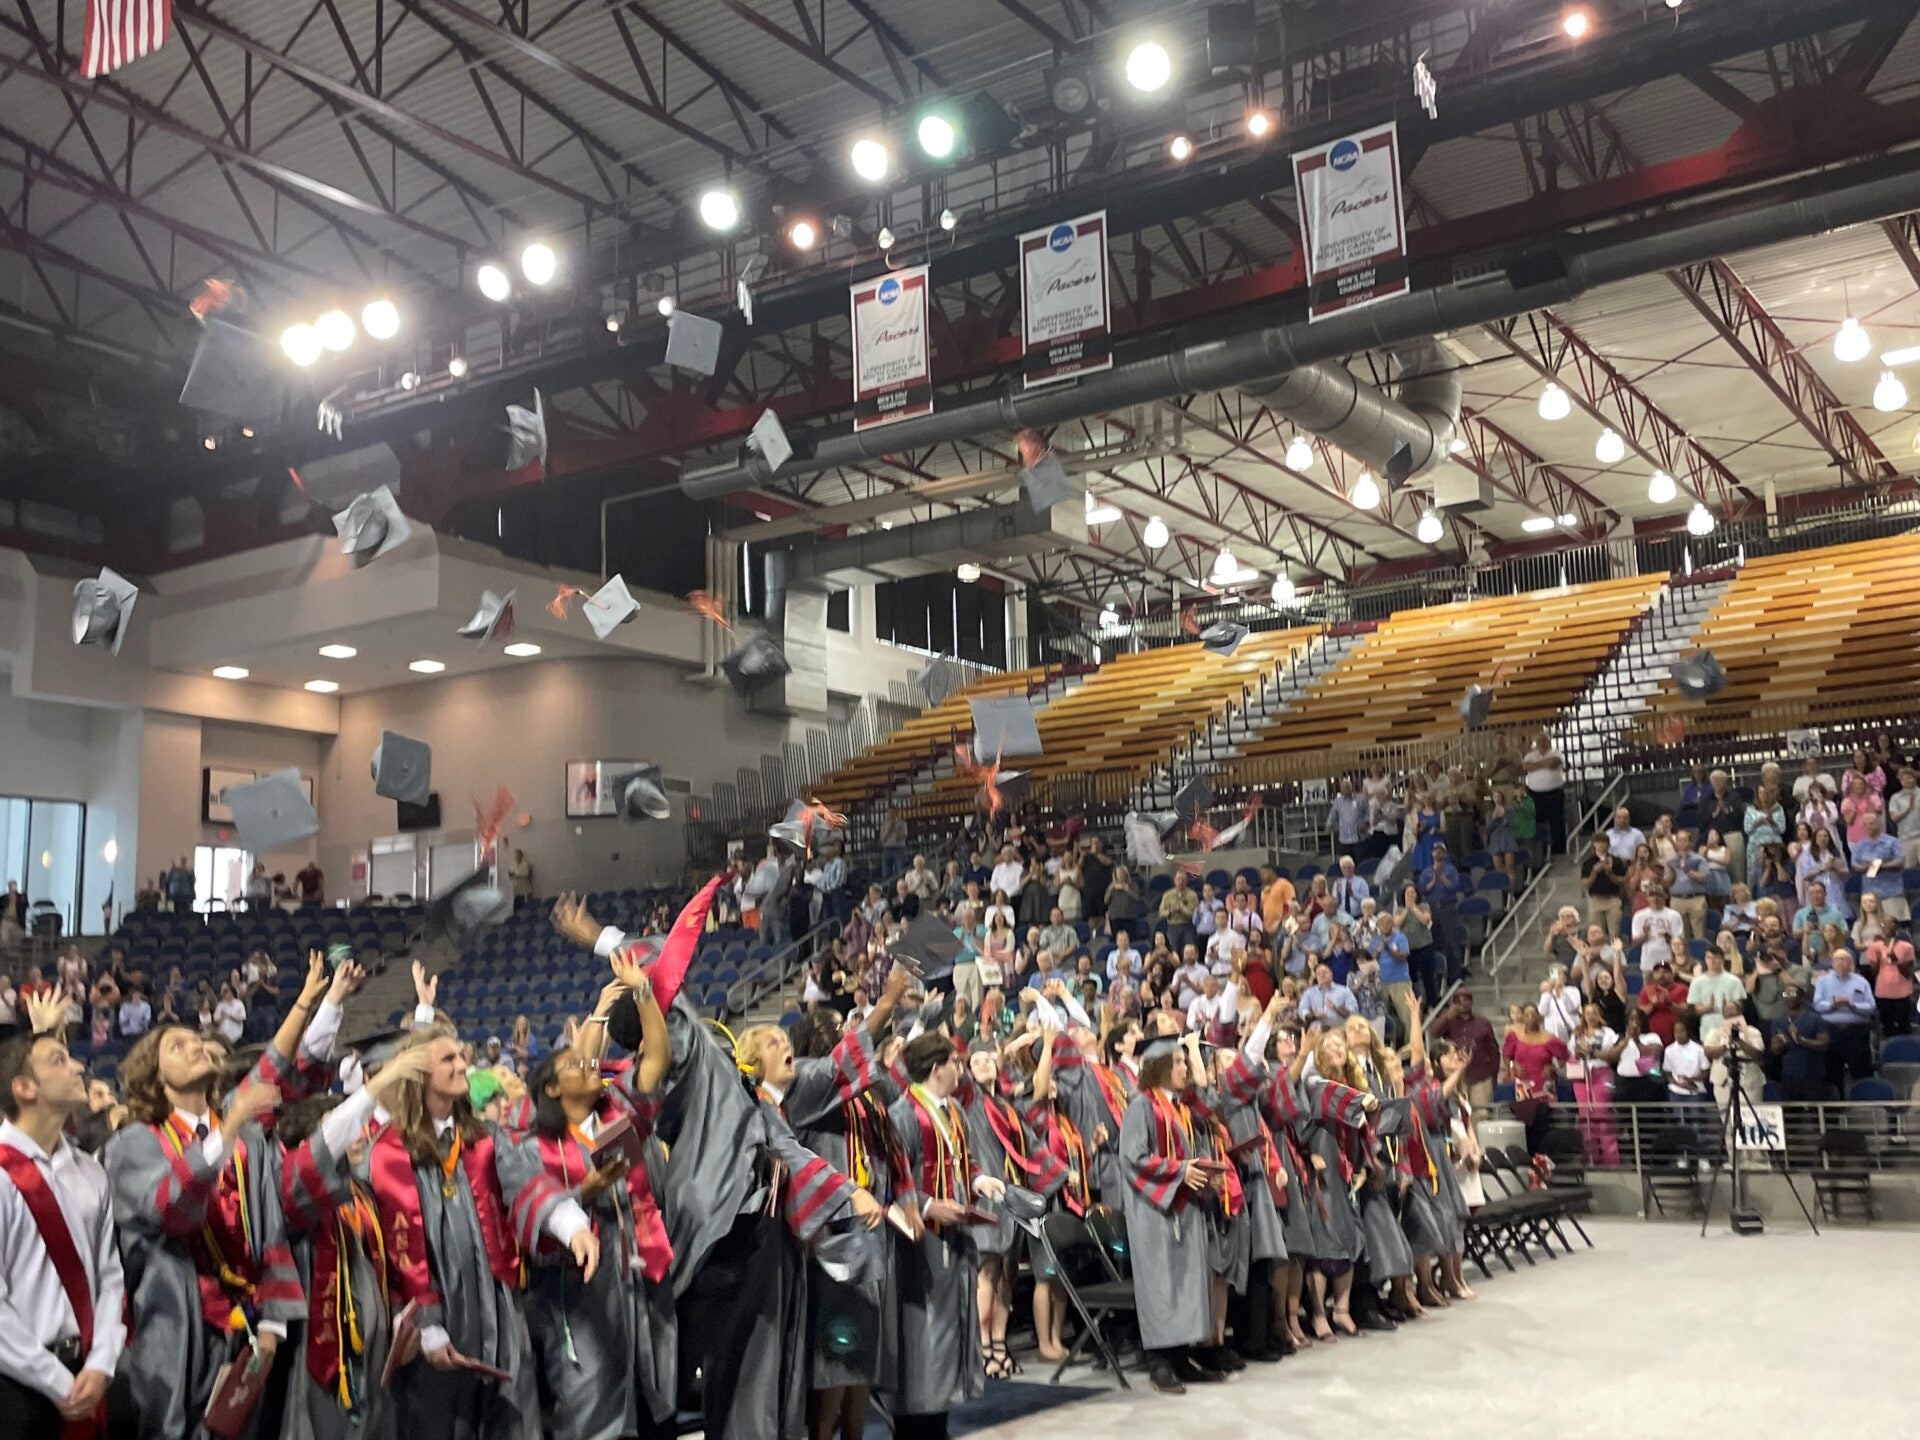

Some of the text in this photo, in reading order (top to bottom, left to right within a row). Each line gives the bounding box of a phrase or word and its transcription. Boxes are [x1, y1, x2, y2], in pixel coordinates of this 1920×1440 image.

[1333, 152, 1359, 167] NCAA
[1331, 191, 1388, 219] Pacers
[1052, 237, 1075, 249] NCAA
[1316, 233, 1392, 261] SOUTH CAROLINA
[1320, 226, 1386, 251] UNIVERSITY OF
[1335, 246, 1375, 263] AT AIKEN
[1047, 272, 1097, 296] Pacers
[1337, 268, 1376, 288] MEN'S GOLF
[1339, 278, 1375, 296] CHAMPION
[1032, 311, 1099, 333] SOUTH CAROLINA
[1037, 305, 1094, 325] UNIVERSITY OF
[875, 327, 919, 346] Pacers
[1050, 351, 1082, 366] CHAMPION
